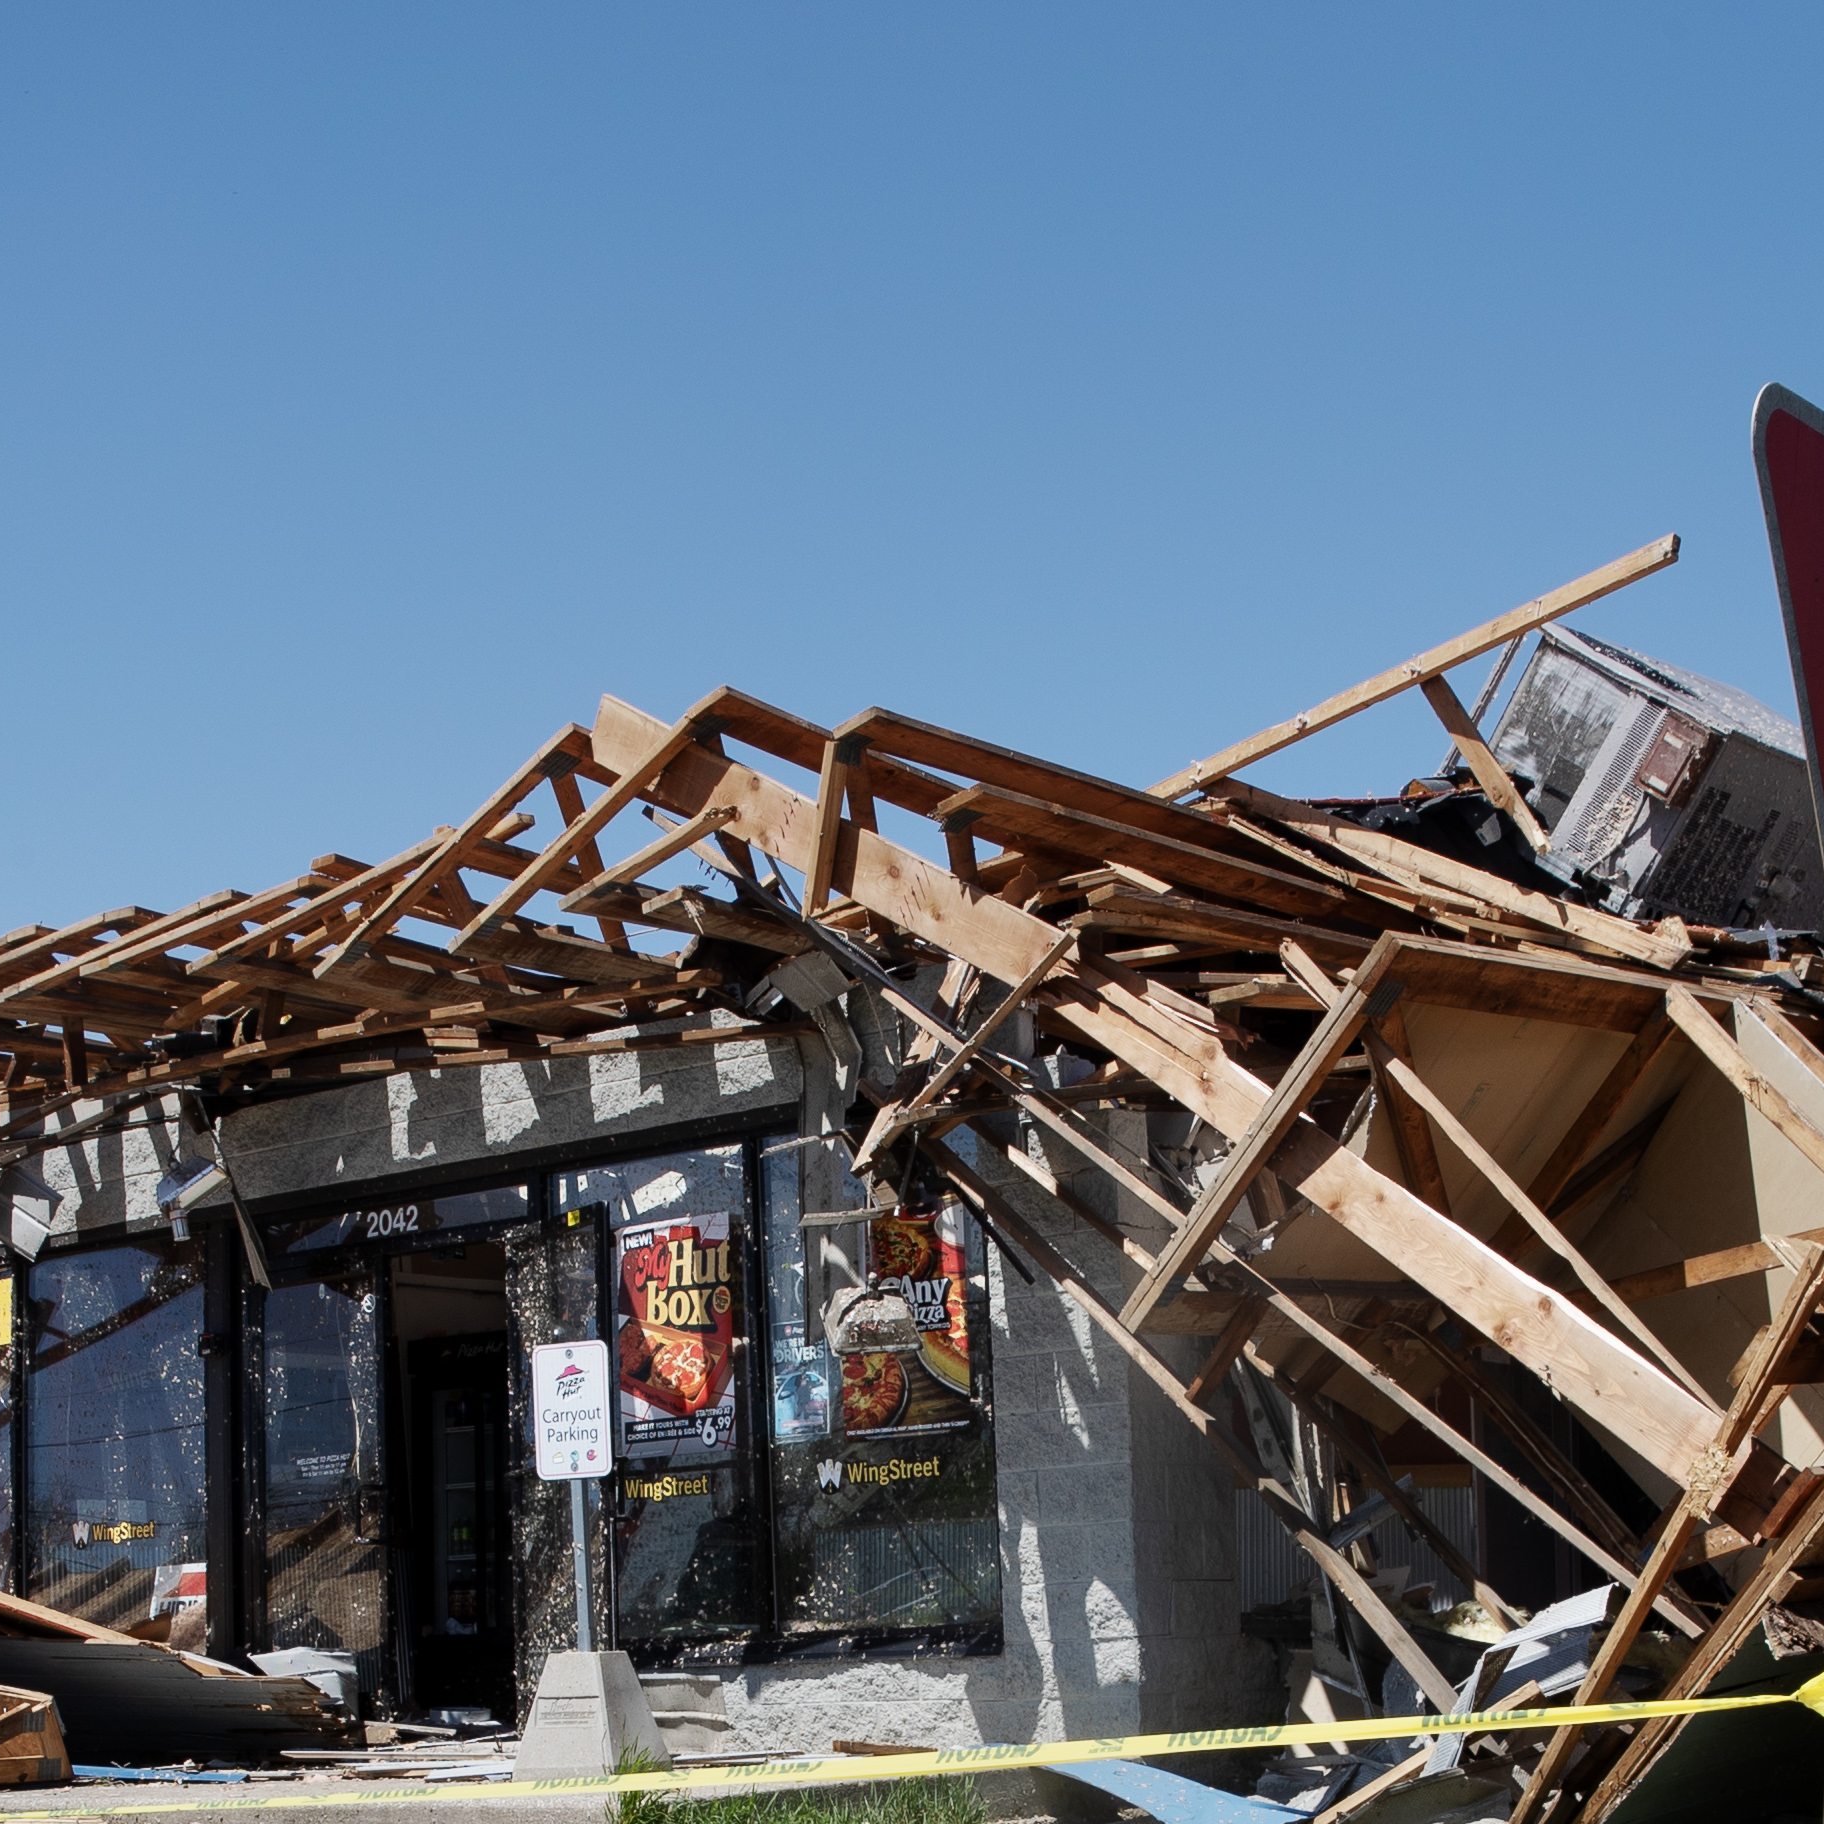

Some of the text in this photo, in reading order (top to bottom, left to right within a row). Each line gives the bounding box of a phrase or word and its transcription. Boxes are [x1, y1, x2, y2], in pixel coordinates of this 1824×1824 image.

[366, 1205, 419, 1238] 2042
[625, 1232, 653, 1250] NEW!
[635, 1238, 731, 1291] My Hut
[900, 1275, 949, 1305] Any
[457, 1340, 505, 1358] Pizza Hut
[775, 1345, 824, 1363] DRIVERS
[556, 1376, 586, 1396] Pizza
[562, 1385, 582, 1400] Hut
[542, 1407, 602, 1425] Carryout
[547, 1427, 598, 1444] Parking
[696, 1415, 732, 1446] $6.99
[847, 1456, 940, 1486] WingStreet
[625, 1475, 708, 1501] WingStreet
[92, 1521, 155, 1544] WingStreet
